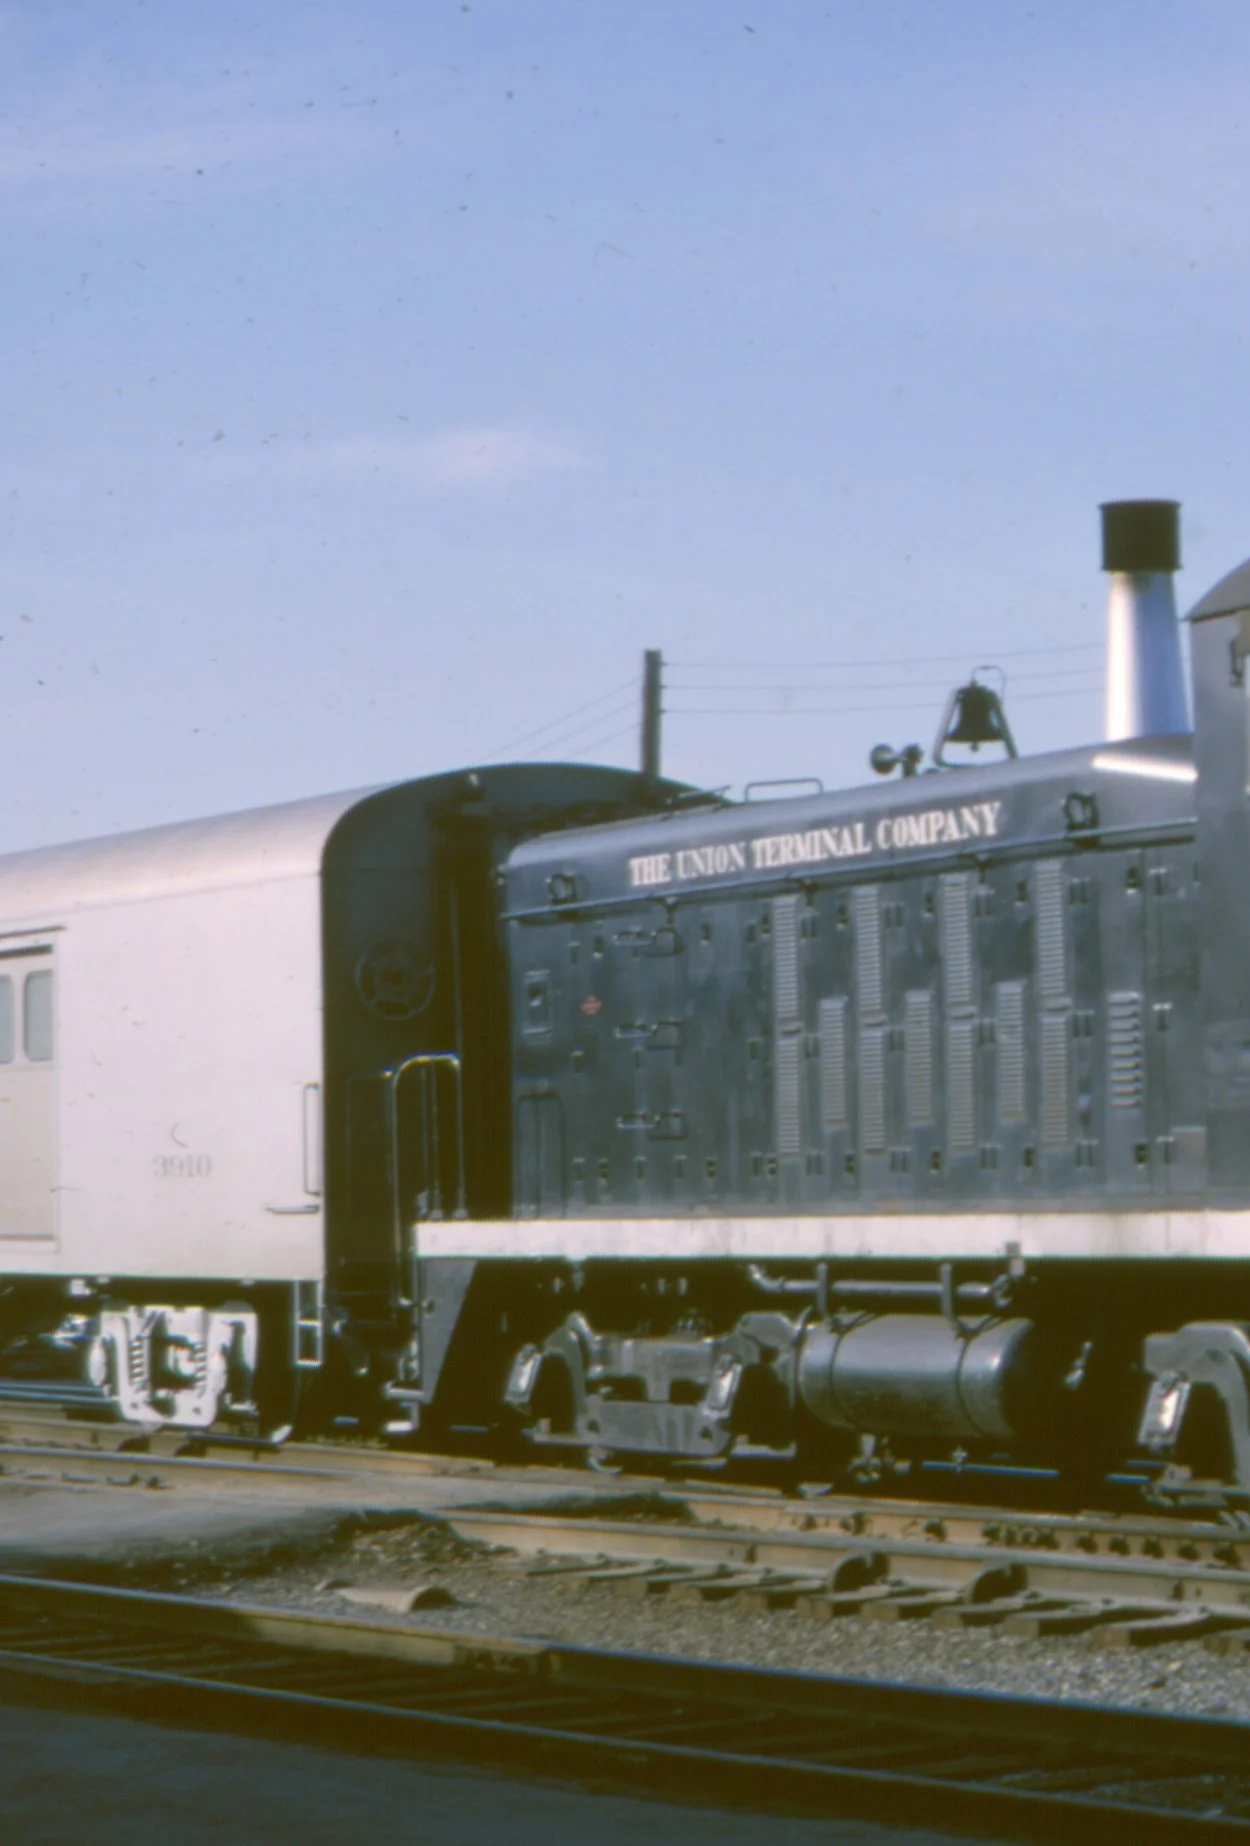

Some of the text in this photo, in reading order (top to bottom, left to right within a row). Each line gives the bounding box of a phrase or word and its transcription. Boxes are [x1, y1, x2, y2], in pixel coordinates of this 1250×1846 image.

[629, 801, 1001, 887] THE UNION TERMINAL COMPANY
[152, 1154, 213, 1179] 3910
